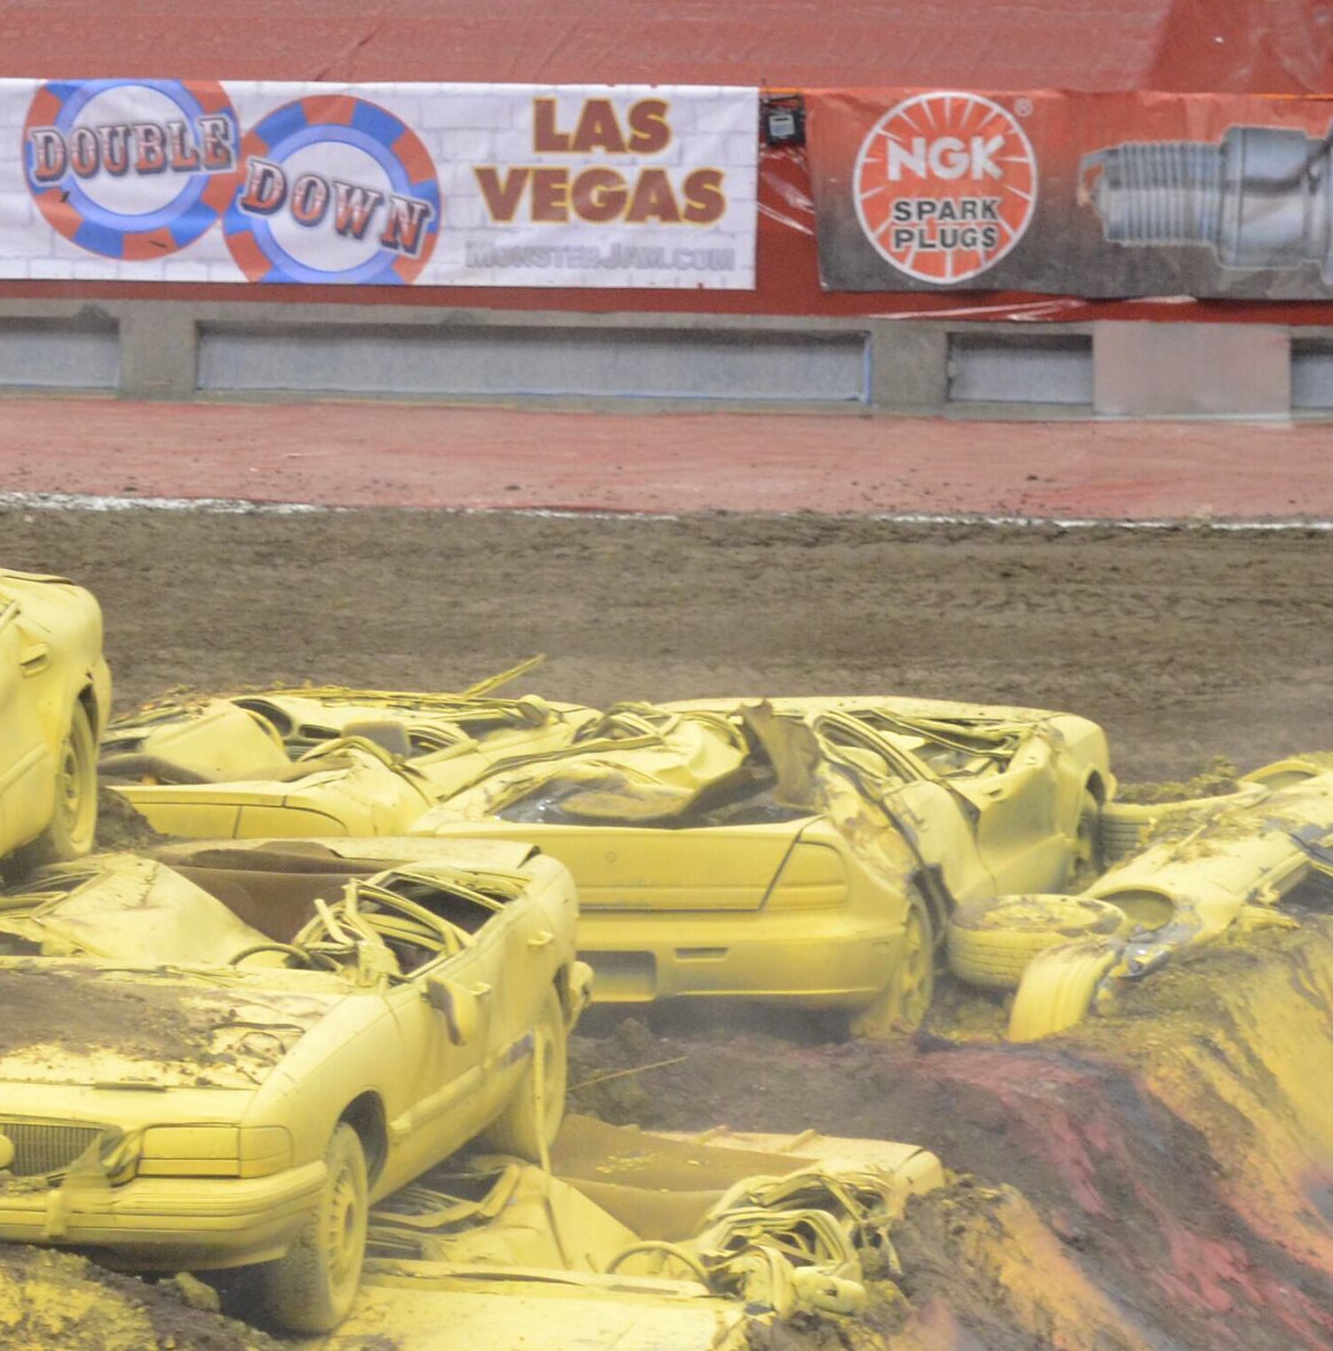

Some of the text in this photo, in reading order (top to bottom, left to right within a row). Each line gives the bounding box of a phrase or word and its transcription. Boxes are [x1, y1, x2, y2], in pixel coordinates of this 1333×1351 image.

[32, 115, 235, 184] DOUBLE
[533, 97, 671, 155] LAS
[887, 136, 1006, 180] NGK
[241, 158, 432, 255] DOWN
[473, 166, 727, 225] VEGAS
[893, 197, 1001, 221] SPARK
[893, 227, 998, 249] PLUGS
